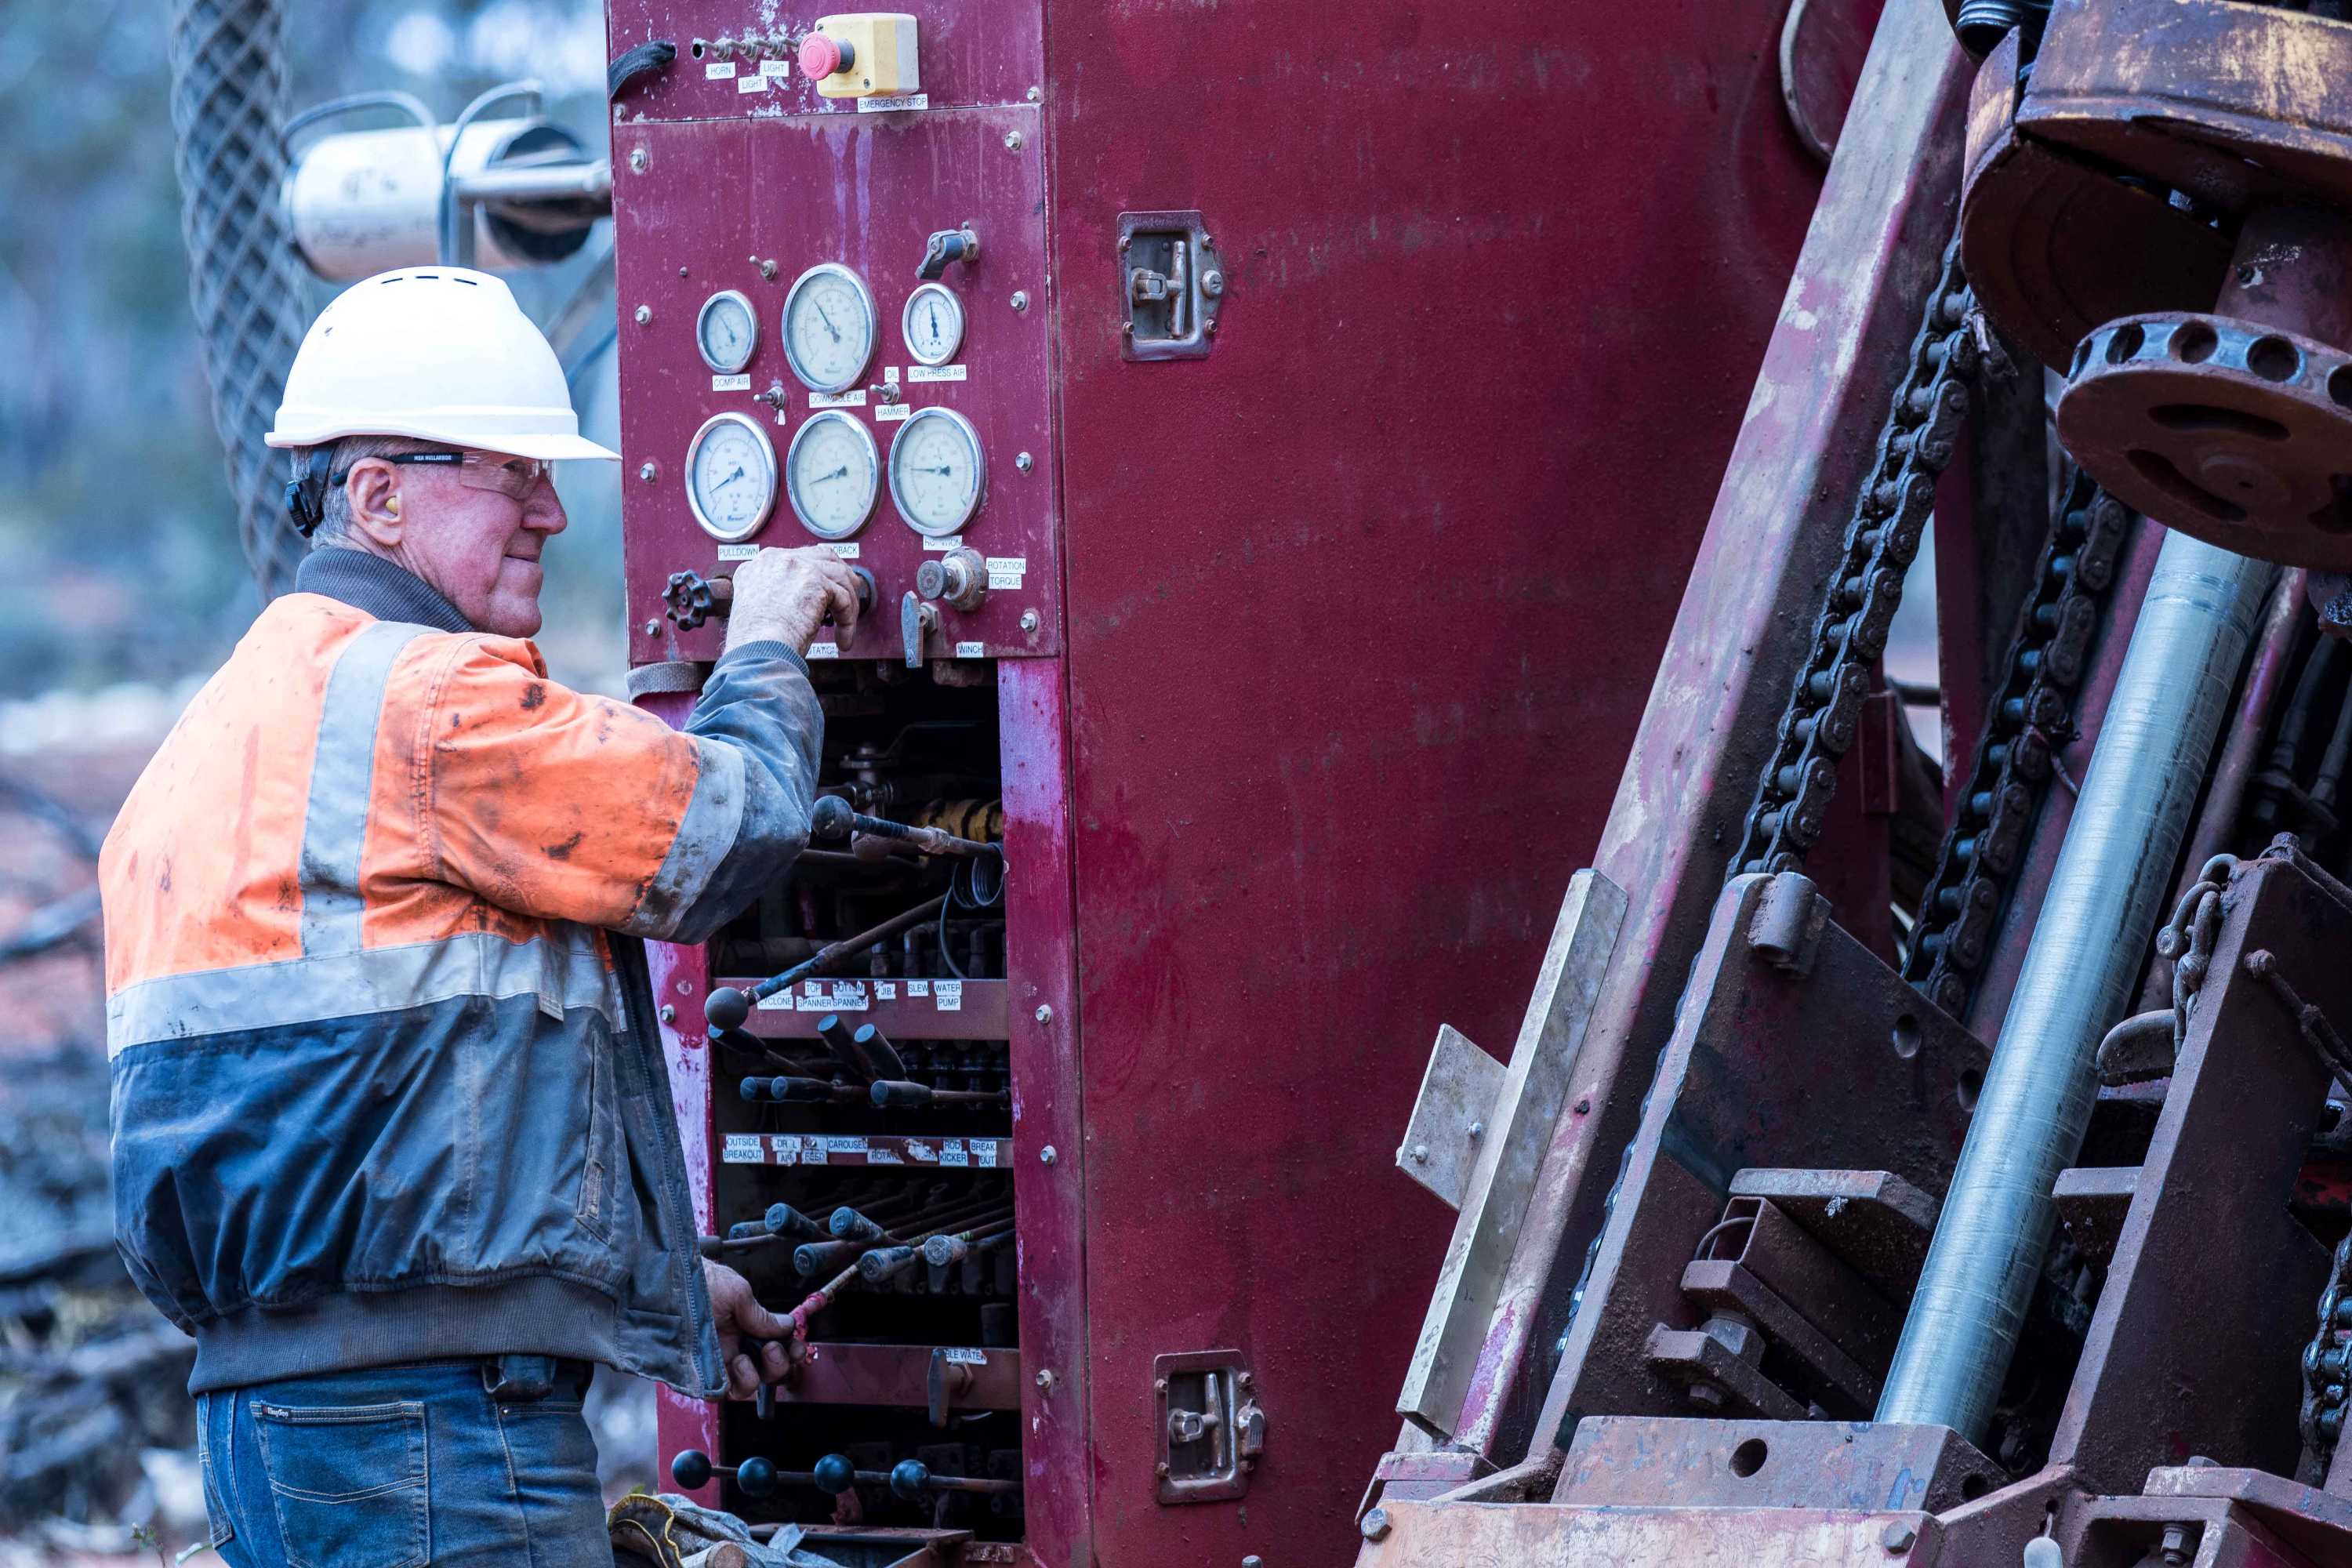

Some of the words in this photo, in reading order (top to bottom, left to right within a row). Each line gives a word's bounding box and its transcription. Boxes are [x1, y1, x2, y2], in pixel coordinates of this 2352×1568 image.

[742, 79, 763, 89] LIGHT
[859, 99, 906, 109] EMERGENCY
[907, 97, 926, 107] STOP
[886, 370, 898, 379] OIL
[811, 394, 852, 404] DOWNLE
[853, 393, 866, 402] AIR
[877, 408, 909, 417] HAMMER
[924, 539, 962, 547] ROTION
[719, 549, 759, 558] PULLDOWN
[988, 561, 1025, 572] ROTATION
[990, 576, 1022, 586] TORQUE
[958, 644, 984, 654] WINCH
[806, 984, 821, 993] TOP
[833, 982, 864, 993] BOTTM
[880, 987, 892, 996] JIB
[908, 984, 928, 993] SLEW
[935, 984, 961, 993] WATER
[797, 999, 833, 1008] SPANNER
[833, 998, 867, 1007] SPANNER
[938, 998, 959, 1007] PUMP
[727, 1137, 759, 1146] OUTSIDE
[777, 1139, 798, 1149] DRL
[828, 1140, 866, 1149] CAROUSEL
[944, 1141, 960, 1150] ROD
[971, 1142, 996, 1152] BREAK
[724, 1149, 763, 1160] BREAKOUT
[940, 1152, 967, 1163] KICKER
[979, 1156, 996, 1165] OUT
